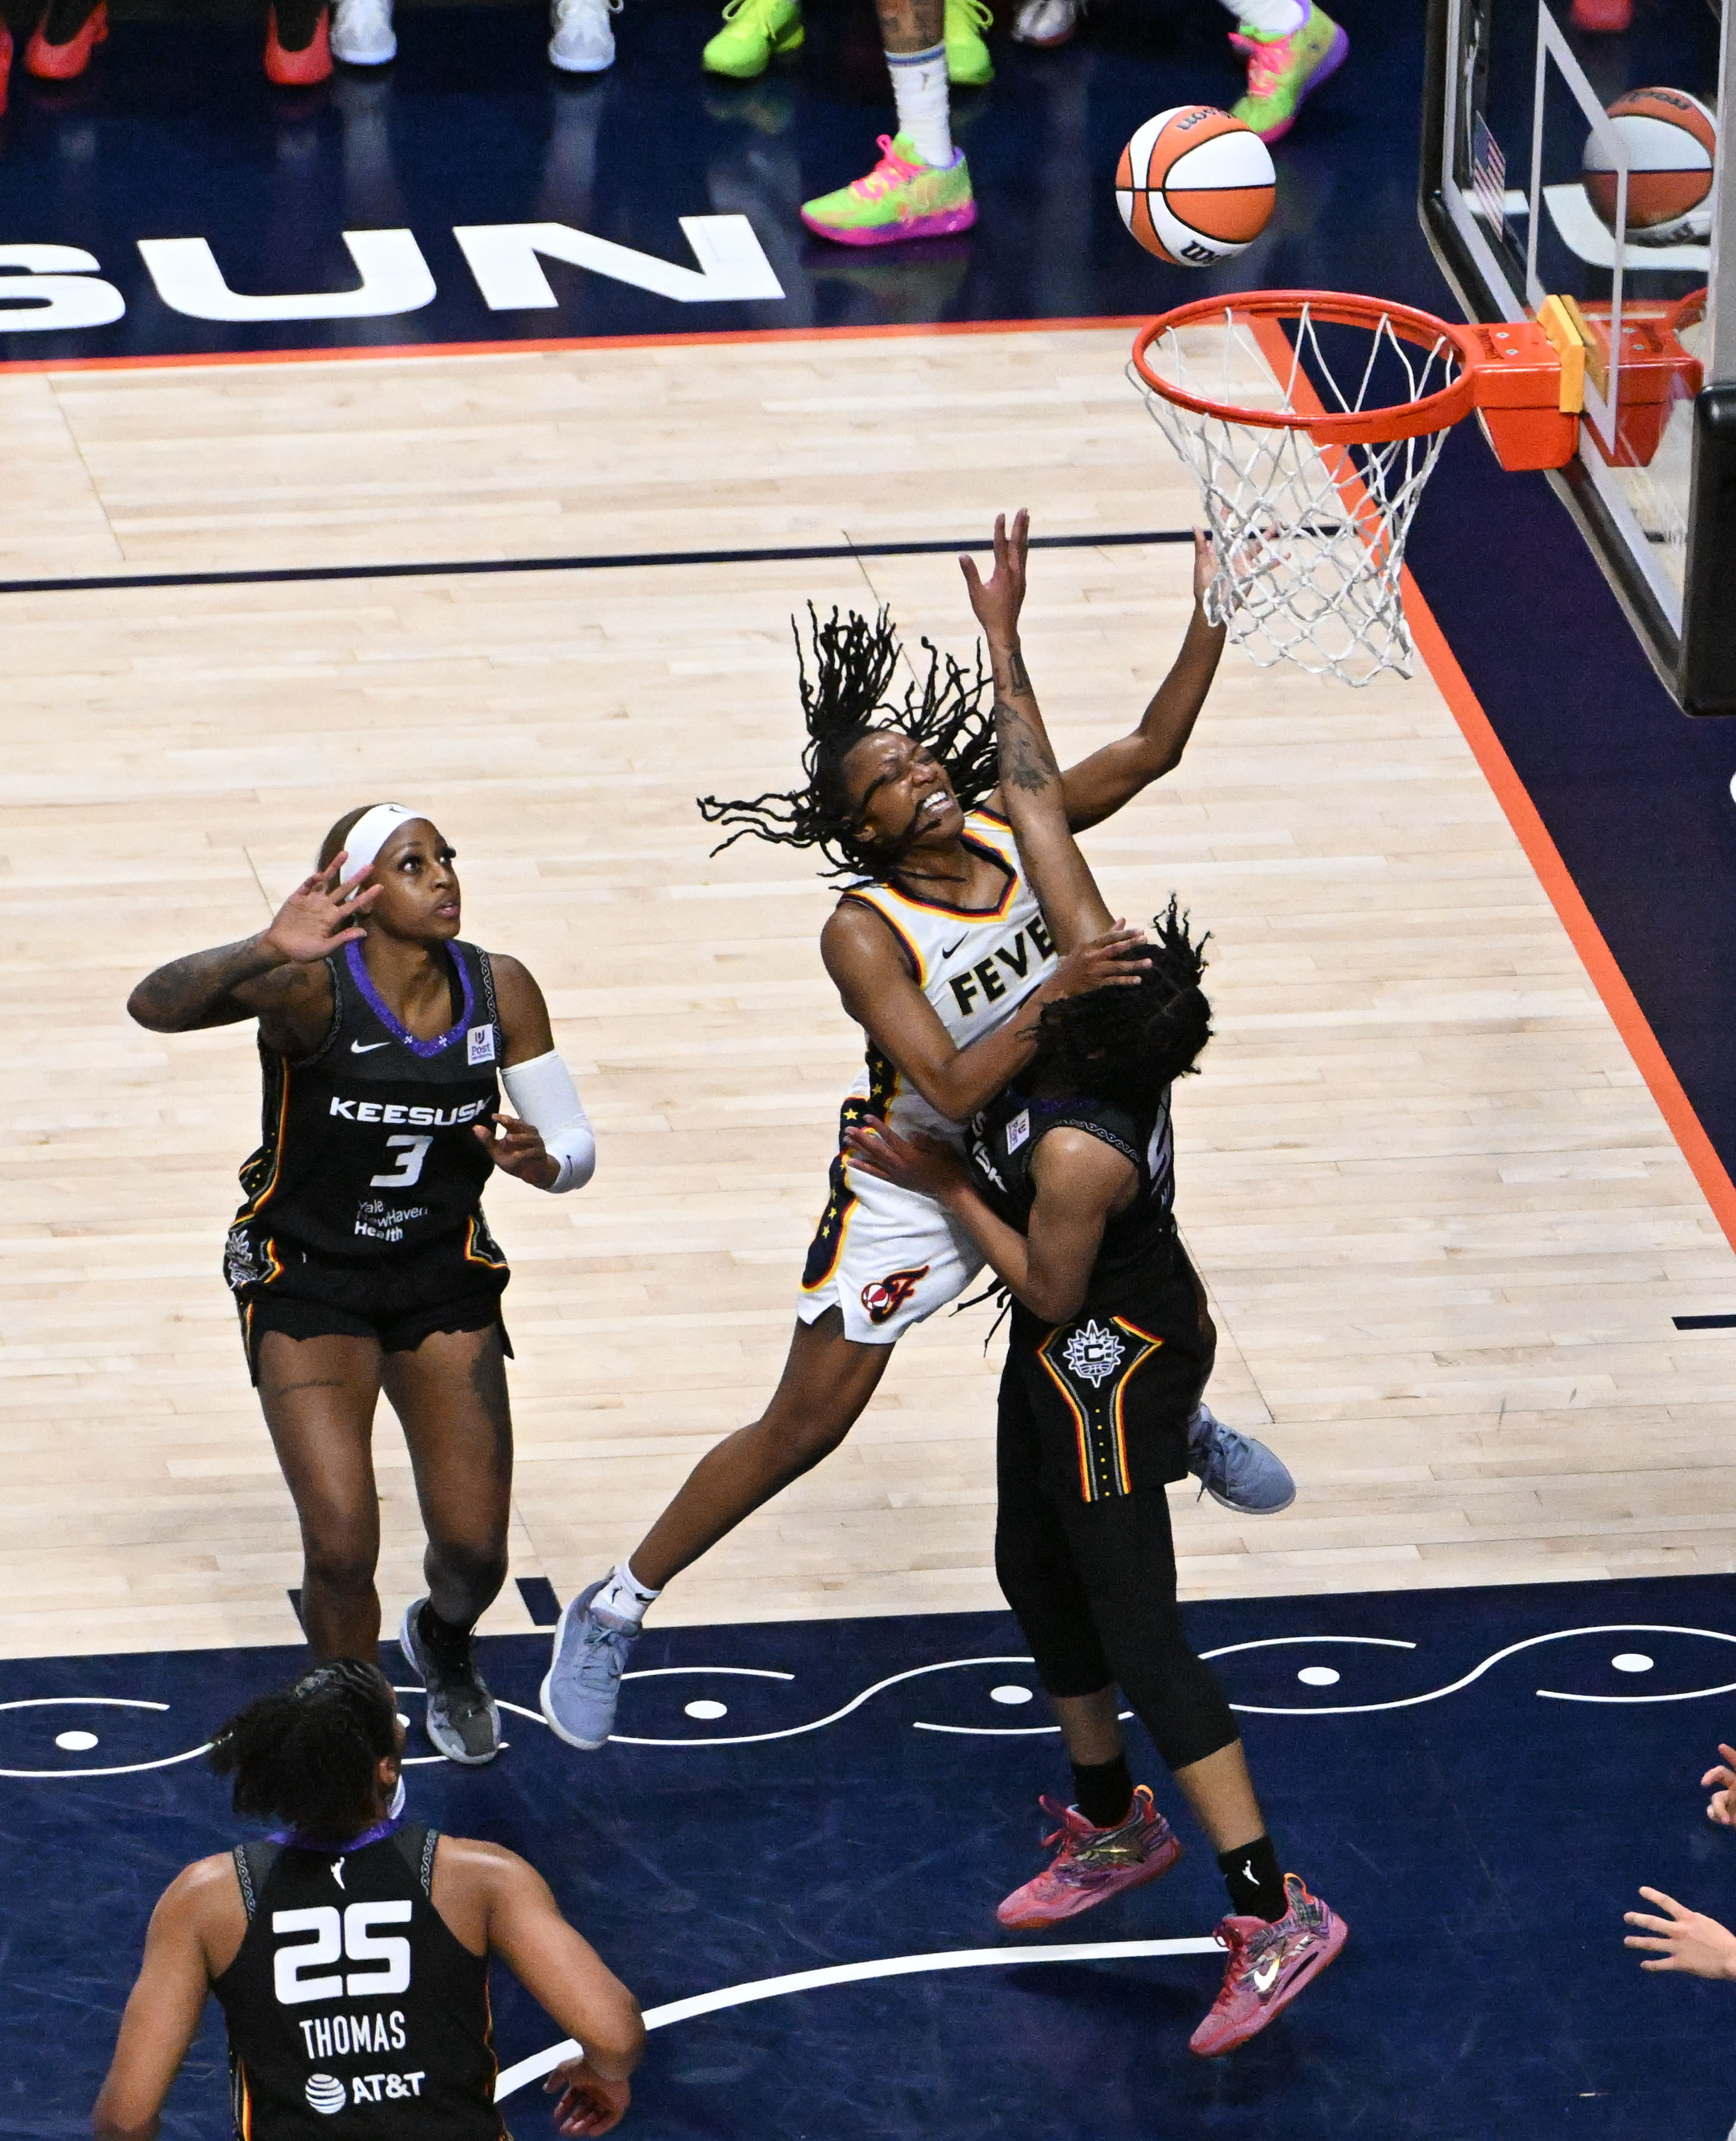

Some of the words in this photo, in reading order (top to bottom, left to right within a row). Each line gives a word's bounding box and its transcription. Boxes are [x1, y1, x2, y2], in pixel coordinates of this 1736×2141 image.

[369, 1135, 434, 1187] 3
[358, 1199, 384, 1214] Yale
[354, 1220, 403, 1242] Health
[272, 1900, 412, 2004] 25
[299, 2010, 406, 2060] THOMAS
[352, 2071, 425, 2104] AT&T
